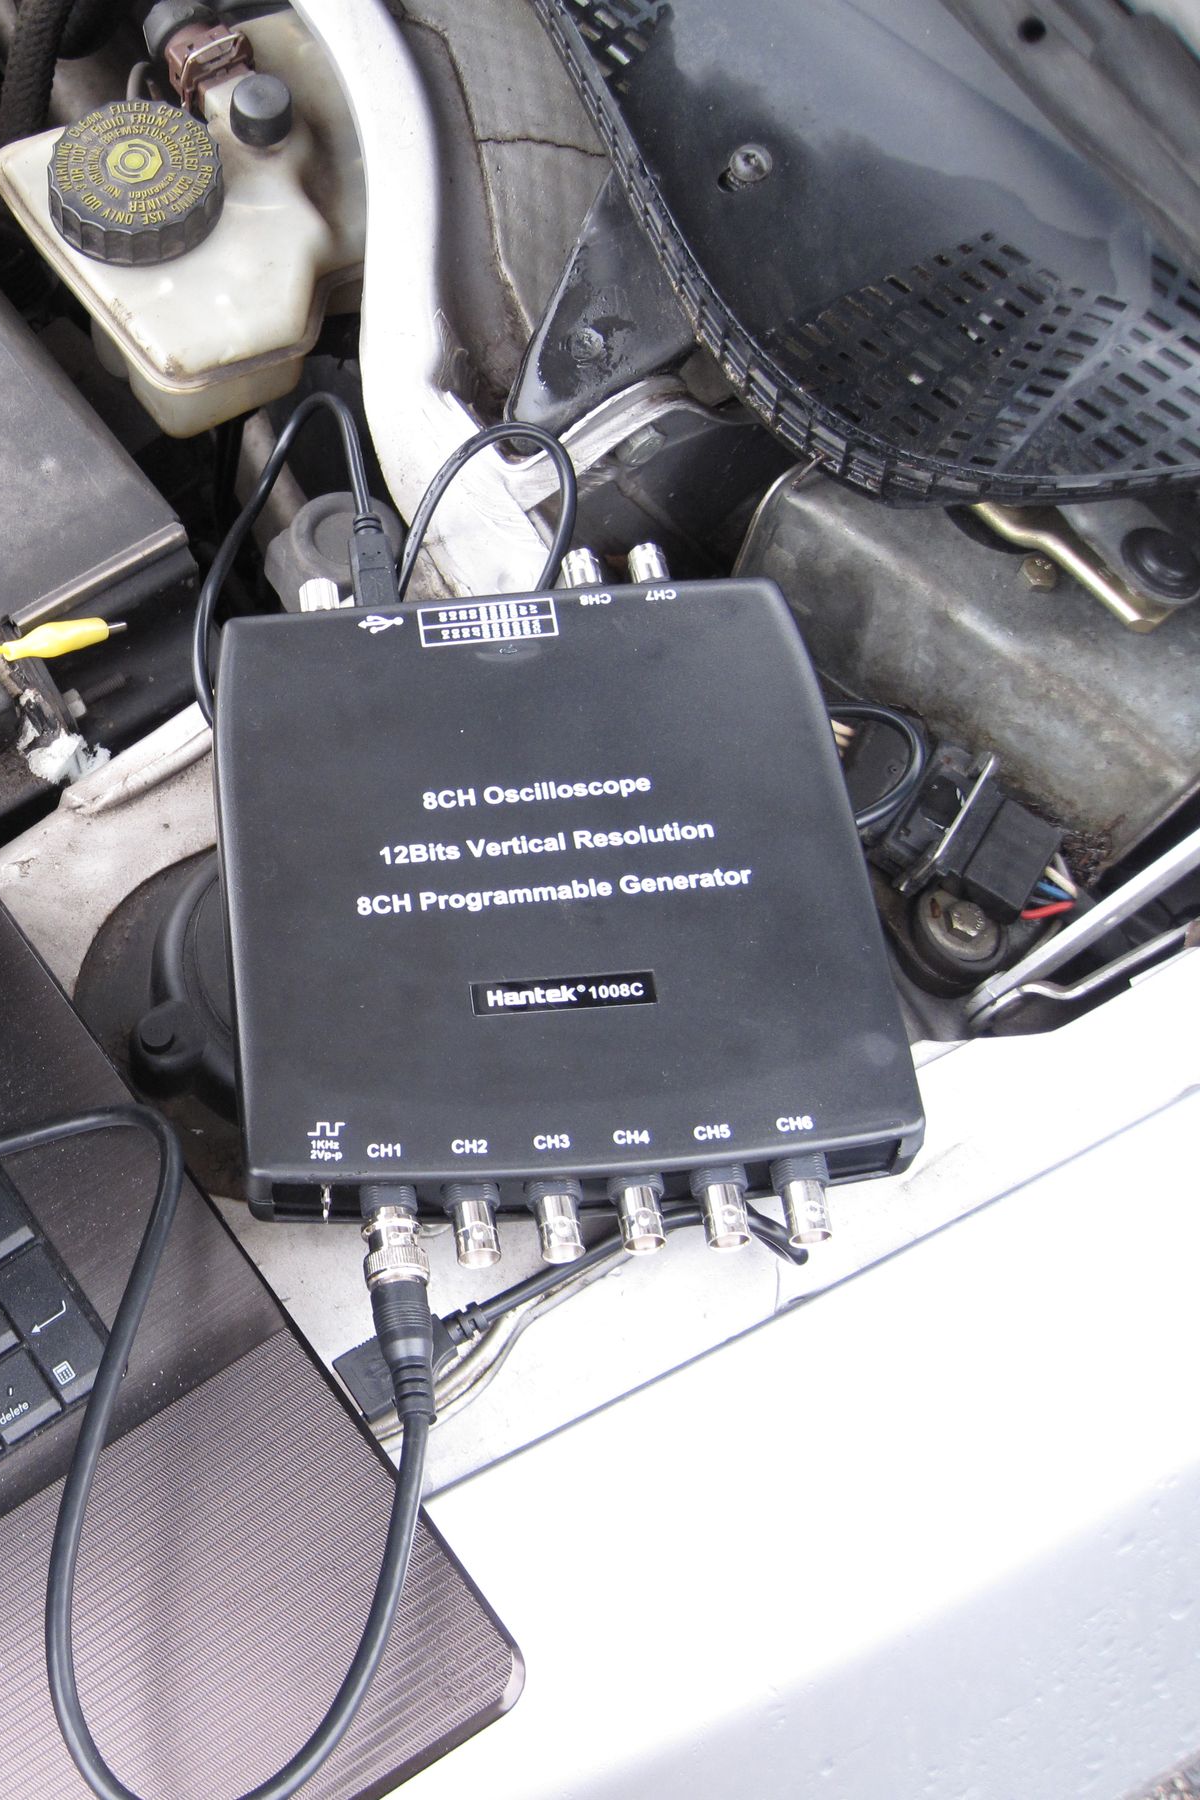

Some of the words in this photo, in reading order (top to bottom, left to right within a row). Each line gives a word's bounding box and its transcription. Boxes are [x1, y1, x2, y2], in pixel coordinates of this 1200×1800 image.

[109, 102, 150, 115] FILLER
[158, 105, 183, 120] CAP
[69, 111, 102, 137] CLEAN
[92, 115, 124, 136] FLUID
[130, 114, 167, 129] FROM
[169, 122, 180, 135] A
[184, 120, 214, 157] BEFORE
[71, 144, 87, 164] DOT
[178, 134, 199, 172] SEALED
[56, 143, 72, 192] WARNING
[70, 167, 85, 180] OR
[75, 182, 87, 192] 3
[129, 175, 194, 213] CONTAINER
[172, 164, 214, 215] REMOVING
[81, 192, 102, 213] DOT
[102, 208, 133, 225] ONLY
[140, 211, 166, 225] USE
[580, 593, 611, 605] CH8
[646, 589, 676, 600] CH7
[423, 789, 476, 809] 8CH
[484, 778, 651, 804] Oscilloscope
[380, 843, 460, 864] 12Bits
[466, 832, 566, 857] Vertical
[573, 823, 714, 849] Resolution
[357, 894, 411, 915] 8CH
[420, 879, 612, 911] Programmable
[620, 868, 751, 894] Generator
[588, 982, 644, 1000] 1008C
[694, 1124, 731, 1140] CH5
[777, 1116, 813, 1132] CH6
[534, 1134, 570, 1149] CH3
[613, 1130, 650, 1144] CH4
[310, 1140, 340, 1151] 1KHz
[367, 1144, 401, 1158] CH1
[452, 1140, 487, 1154] CH2
[311, 1147, 342, 1161] 2Vp-p
[0, 1403, 28, 1424] delete
